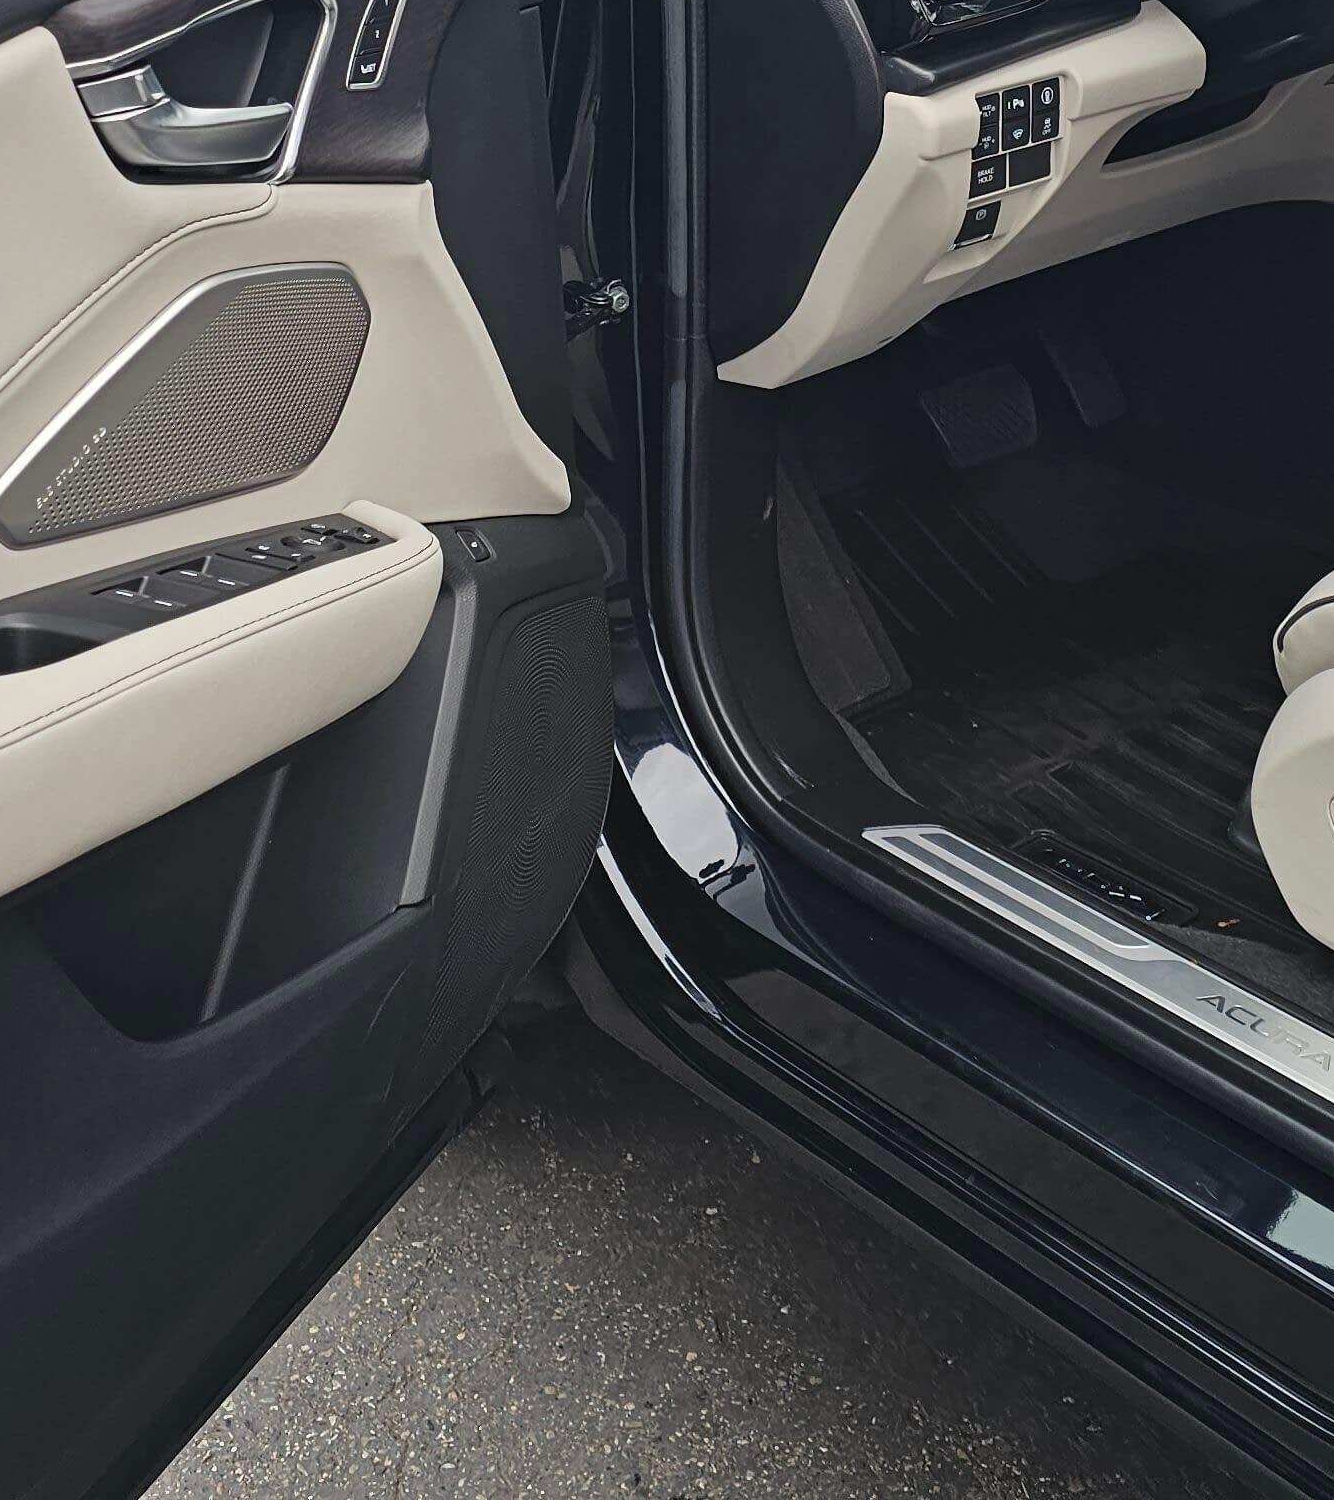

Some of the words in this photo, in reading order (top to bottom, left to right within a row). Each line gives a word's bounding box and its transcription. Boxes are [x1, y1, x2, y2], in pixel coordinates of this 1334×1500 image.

[977, 167, 995, 178] BRAKE
[978, 175, 994, 185] HOLD
[1195, 994, 1332, 1072] ACURA
